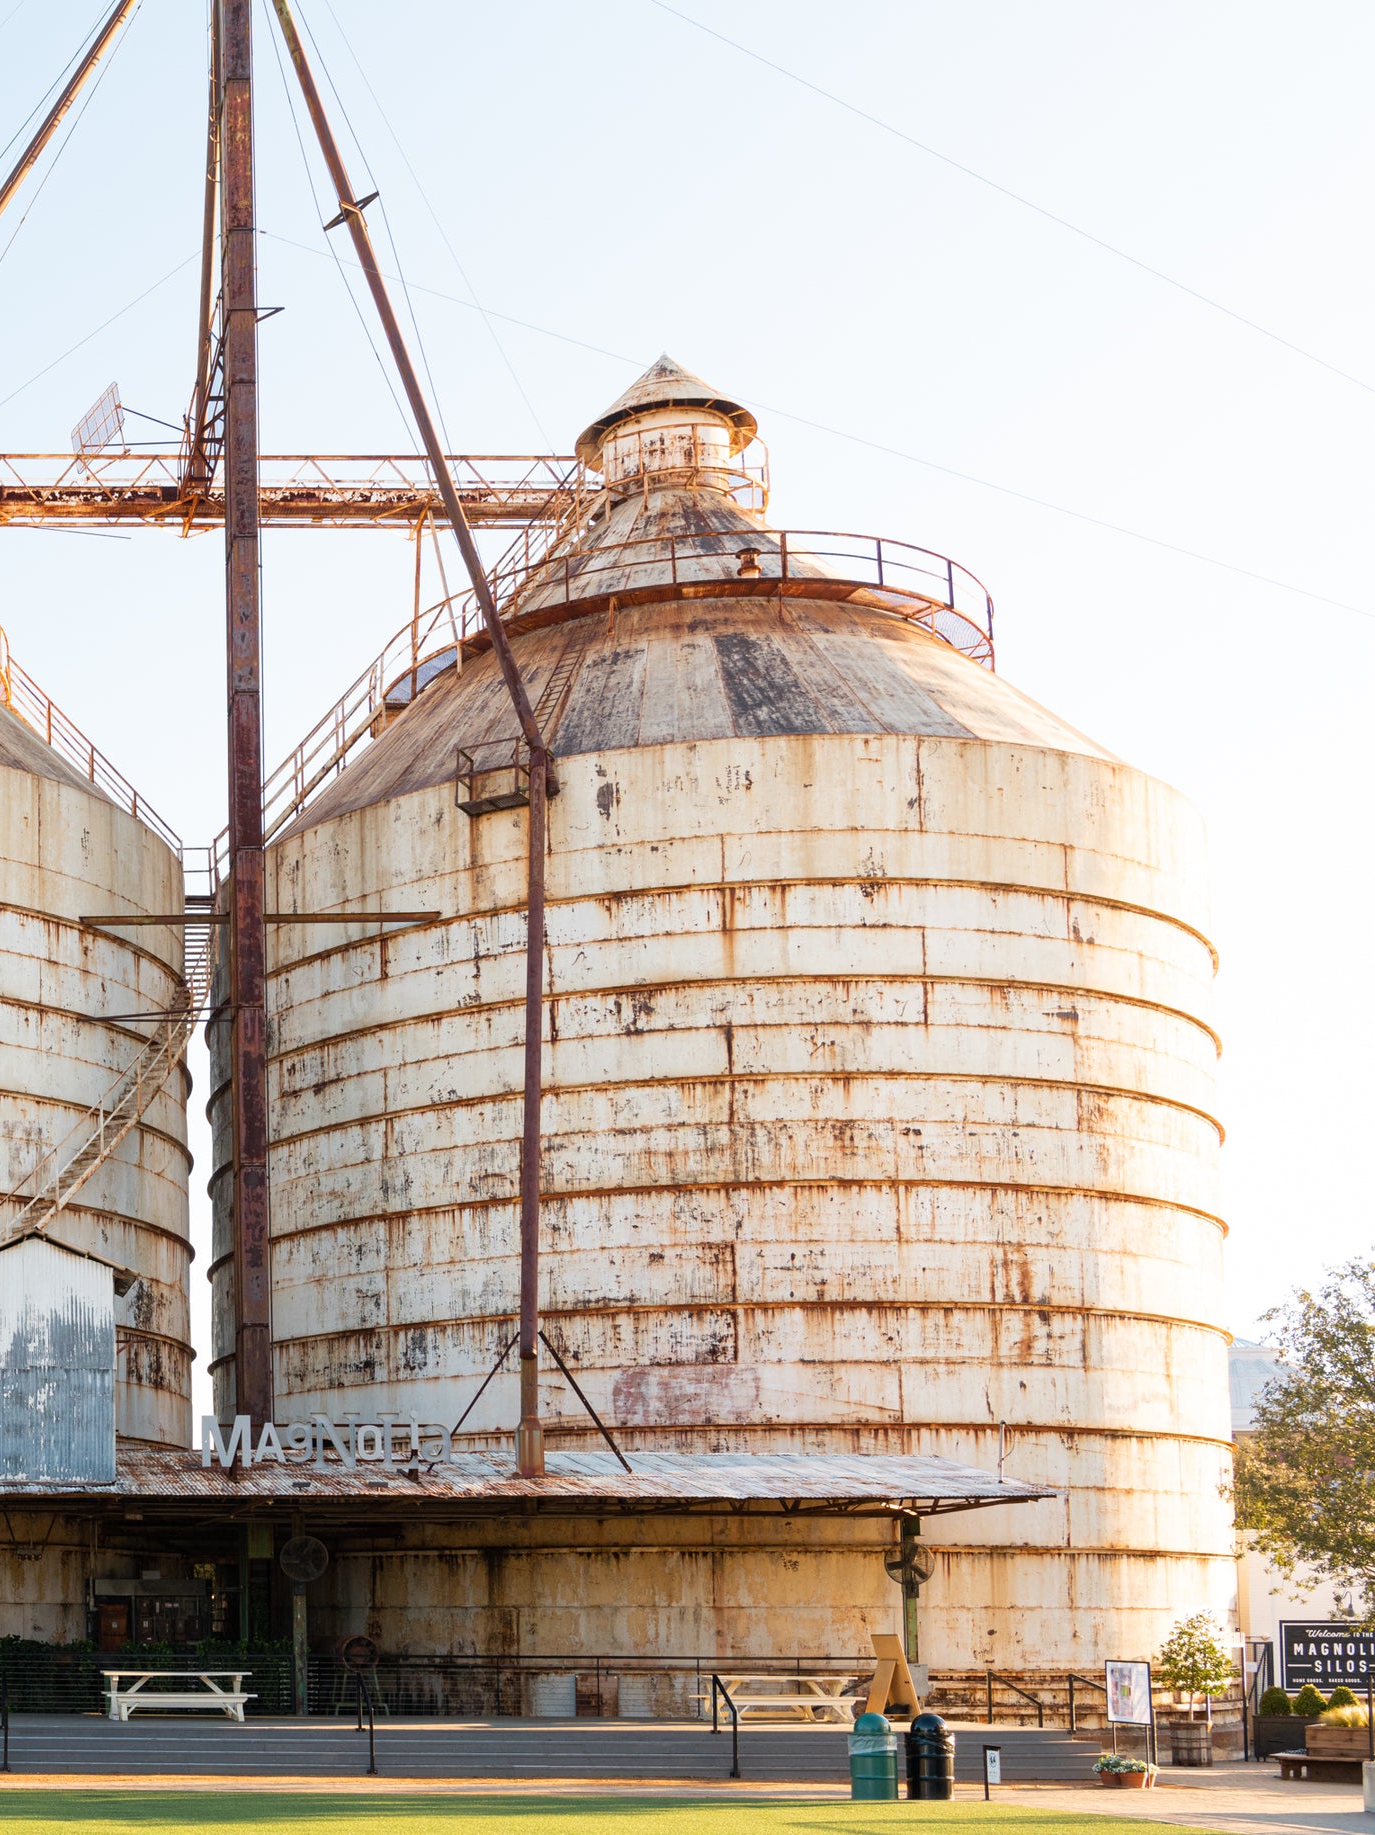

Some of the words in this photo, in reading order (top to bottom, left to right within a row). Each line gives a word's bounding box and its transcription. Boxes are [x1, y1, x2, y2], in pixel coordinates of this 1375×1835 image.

[1305, 1629, 1351, 1638] Welcome
[1293, 1643, 1375, 1656] MAGNOLI
[1314, 1660, 1367, 1673] SILOS
